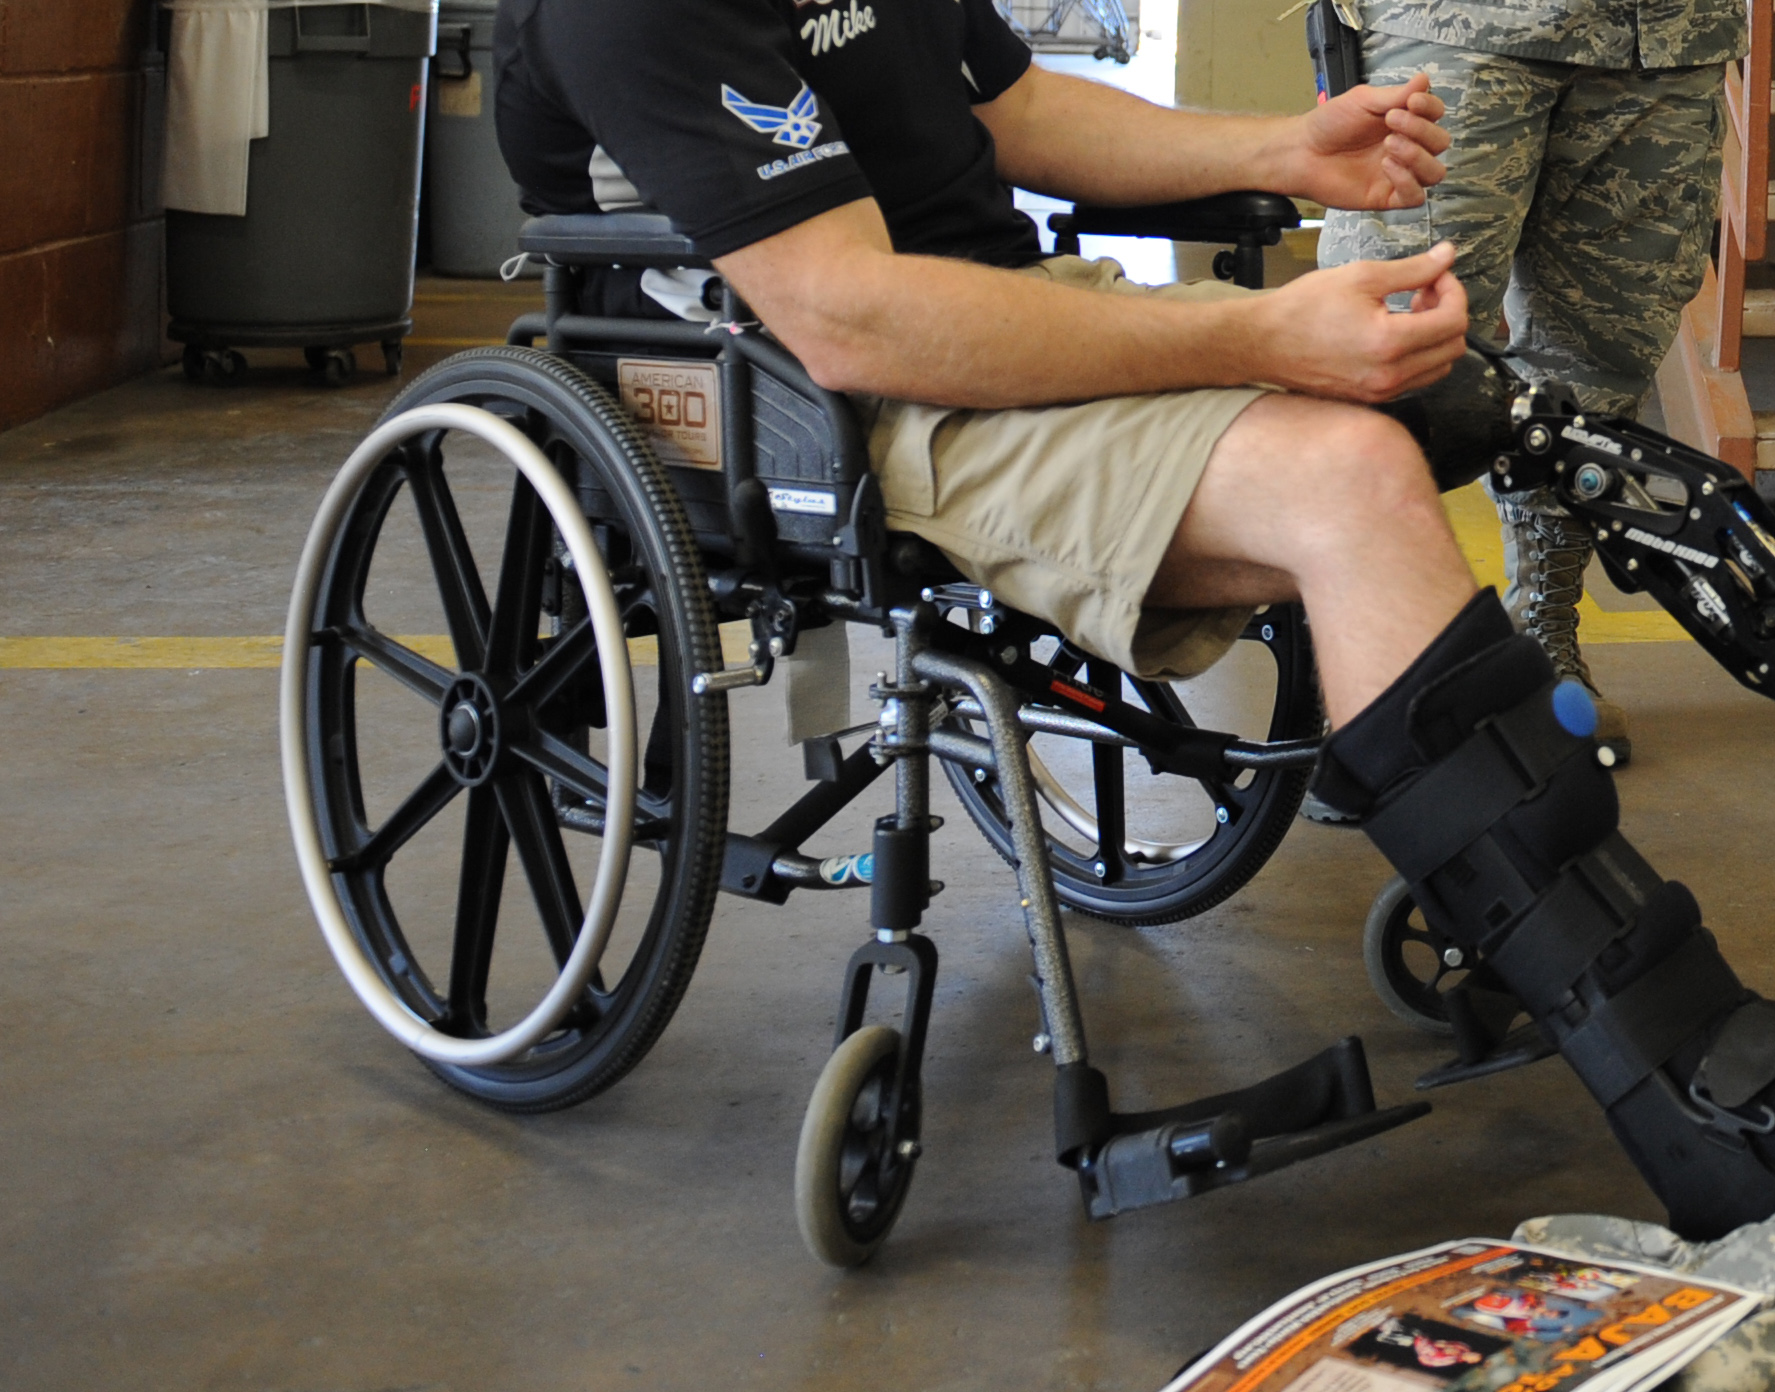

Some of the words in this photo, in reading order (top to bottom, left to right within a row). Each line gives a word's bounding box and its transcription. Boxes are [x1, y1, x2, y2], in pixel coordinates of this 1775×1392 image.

[632, 372, 704, 388] AMERICAN
[633, 387, 707, 428] 300
[676, 430, 707, 441] TOURS
